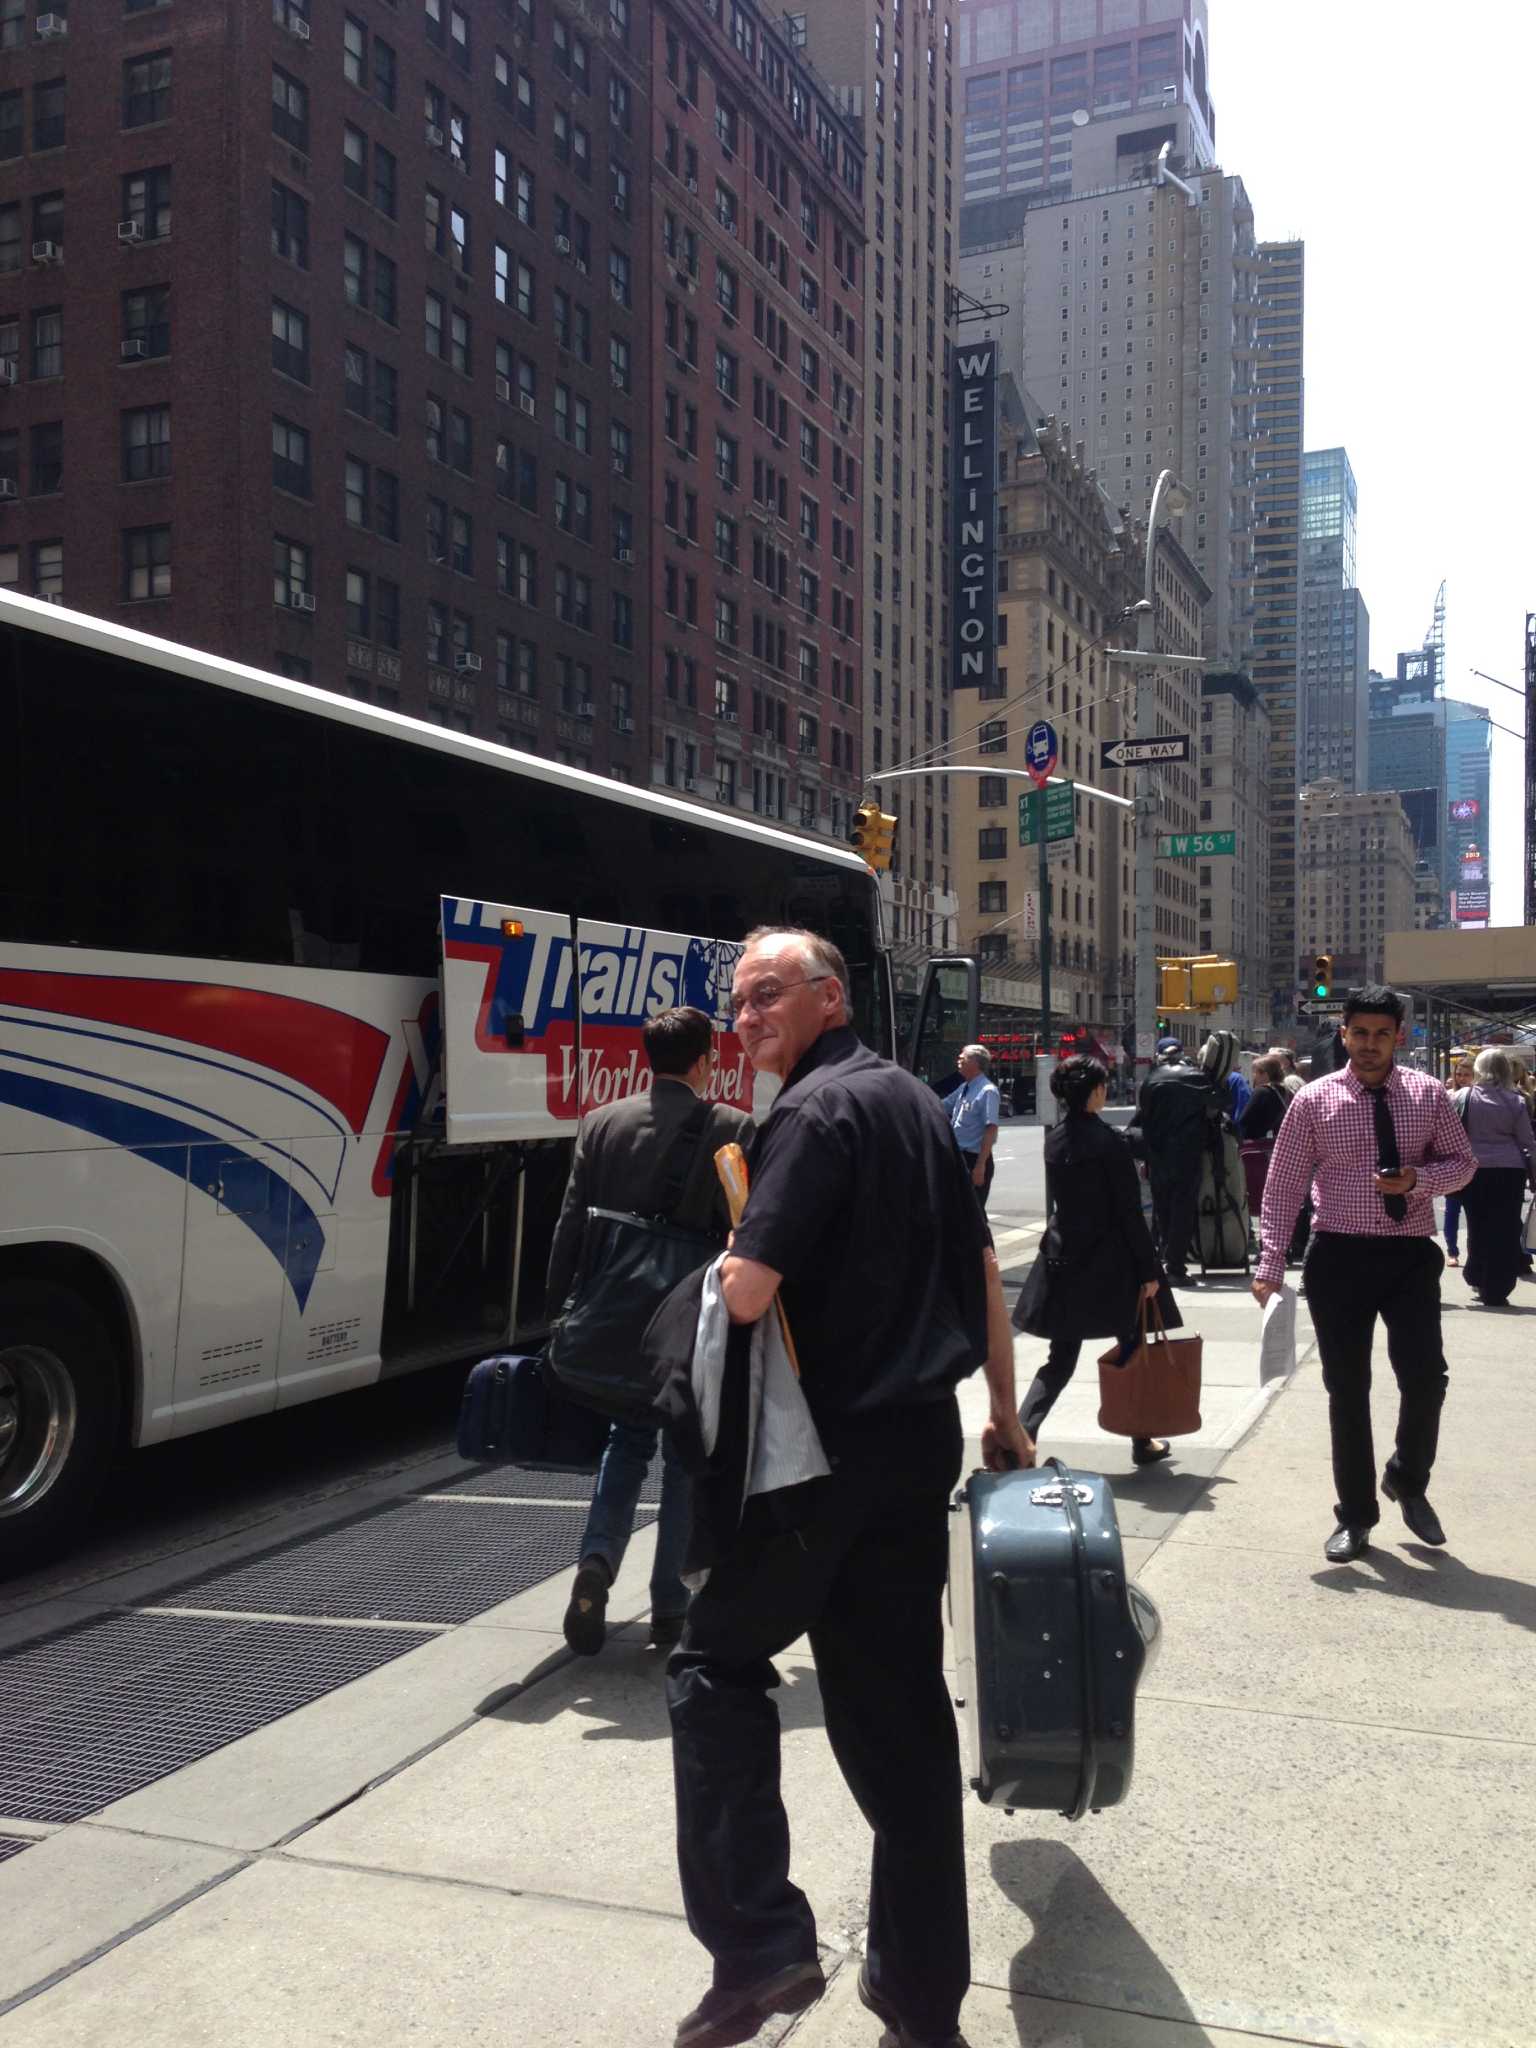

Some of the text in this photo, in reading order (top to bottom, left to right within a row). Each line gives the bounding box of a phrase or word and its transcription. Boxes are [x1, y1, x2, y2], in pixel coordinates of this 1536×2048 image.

[958, 352, 991, 677] WELLINGTON
[1116, 743, 1177, 760] ONE WAY
[1175, 833, 1232, 854] W 56 ST
[480, 901, 678, 1030] Trails
[321, 1331, 348, 1347] BATTERY
